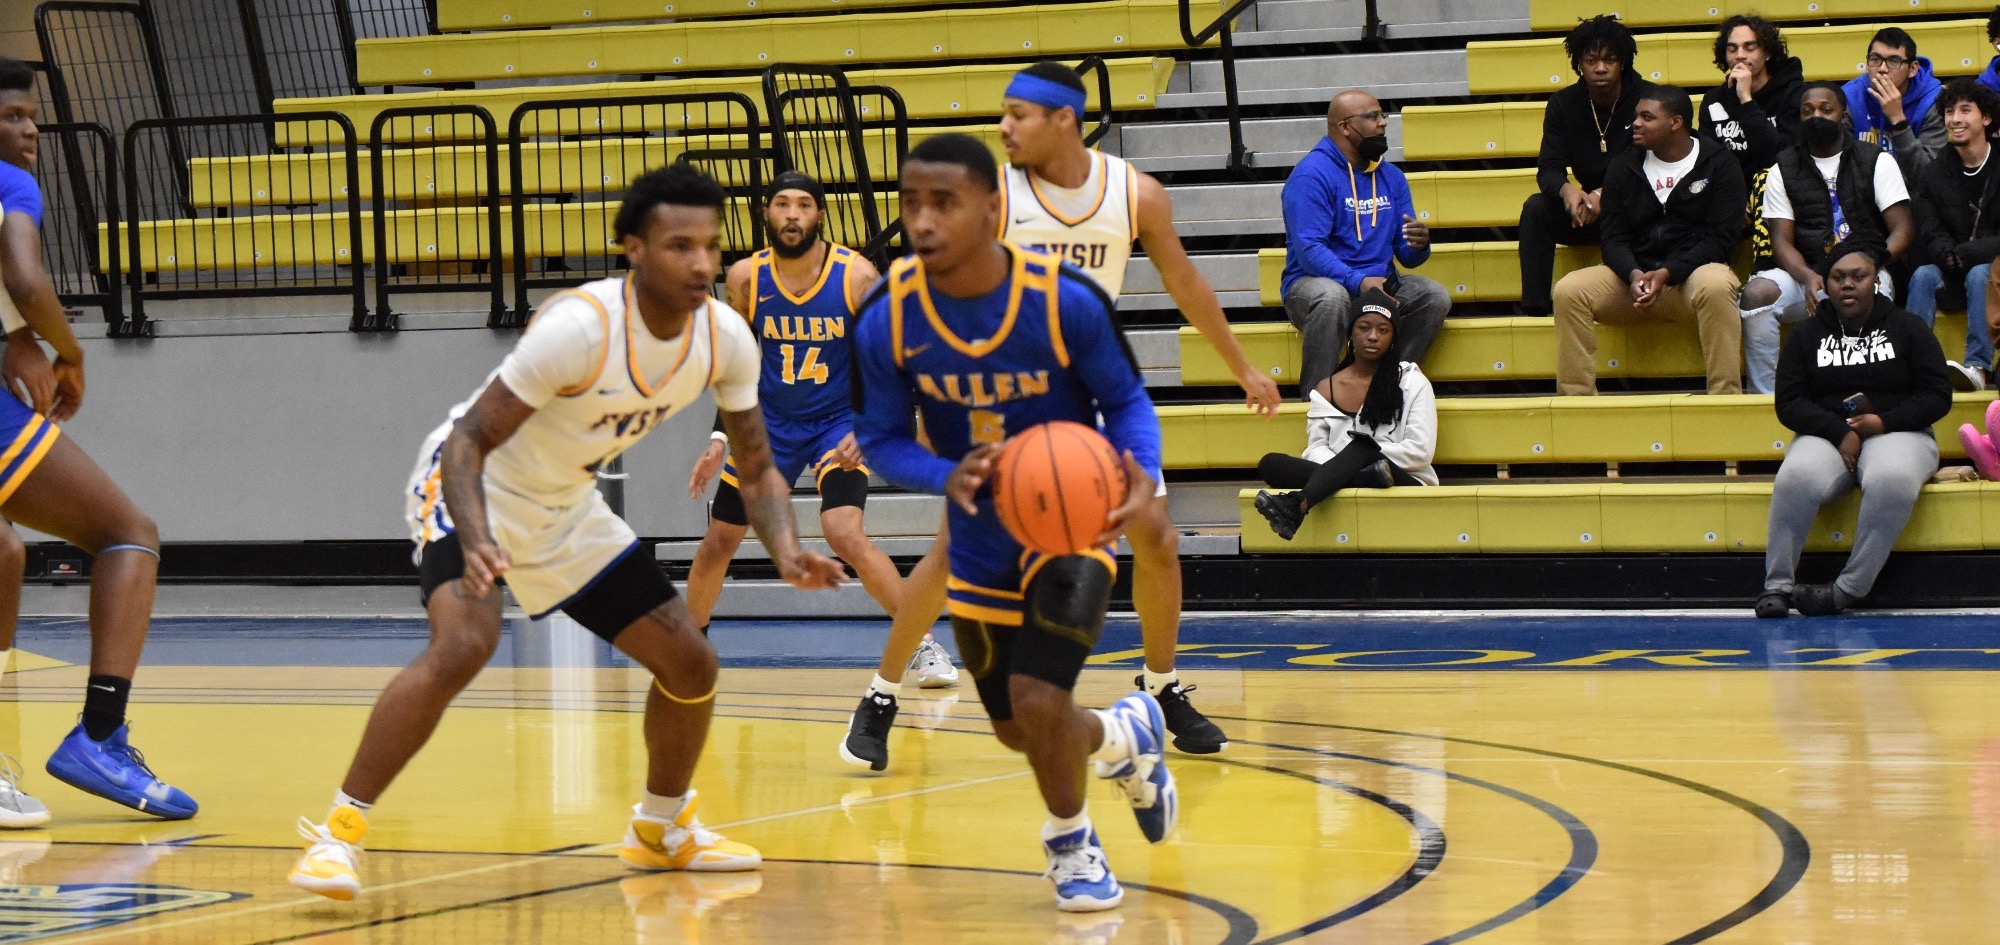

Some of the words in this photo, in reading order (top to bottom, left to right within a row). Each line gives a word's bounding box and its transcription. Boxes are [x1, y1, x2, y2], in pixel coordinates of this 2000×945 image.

[763, 316, 845, 341] ALLEN
[780, 344, 829, 385] 14
[917, 369, 1049, 407] ALLEN
[1083, 644, 2000, 667] FORT
